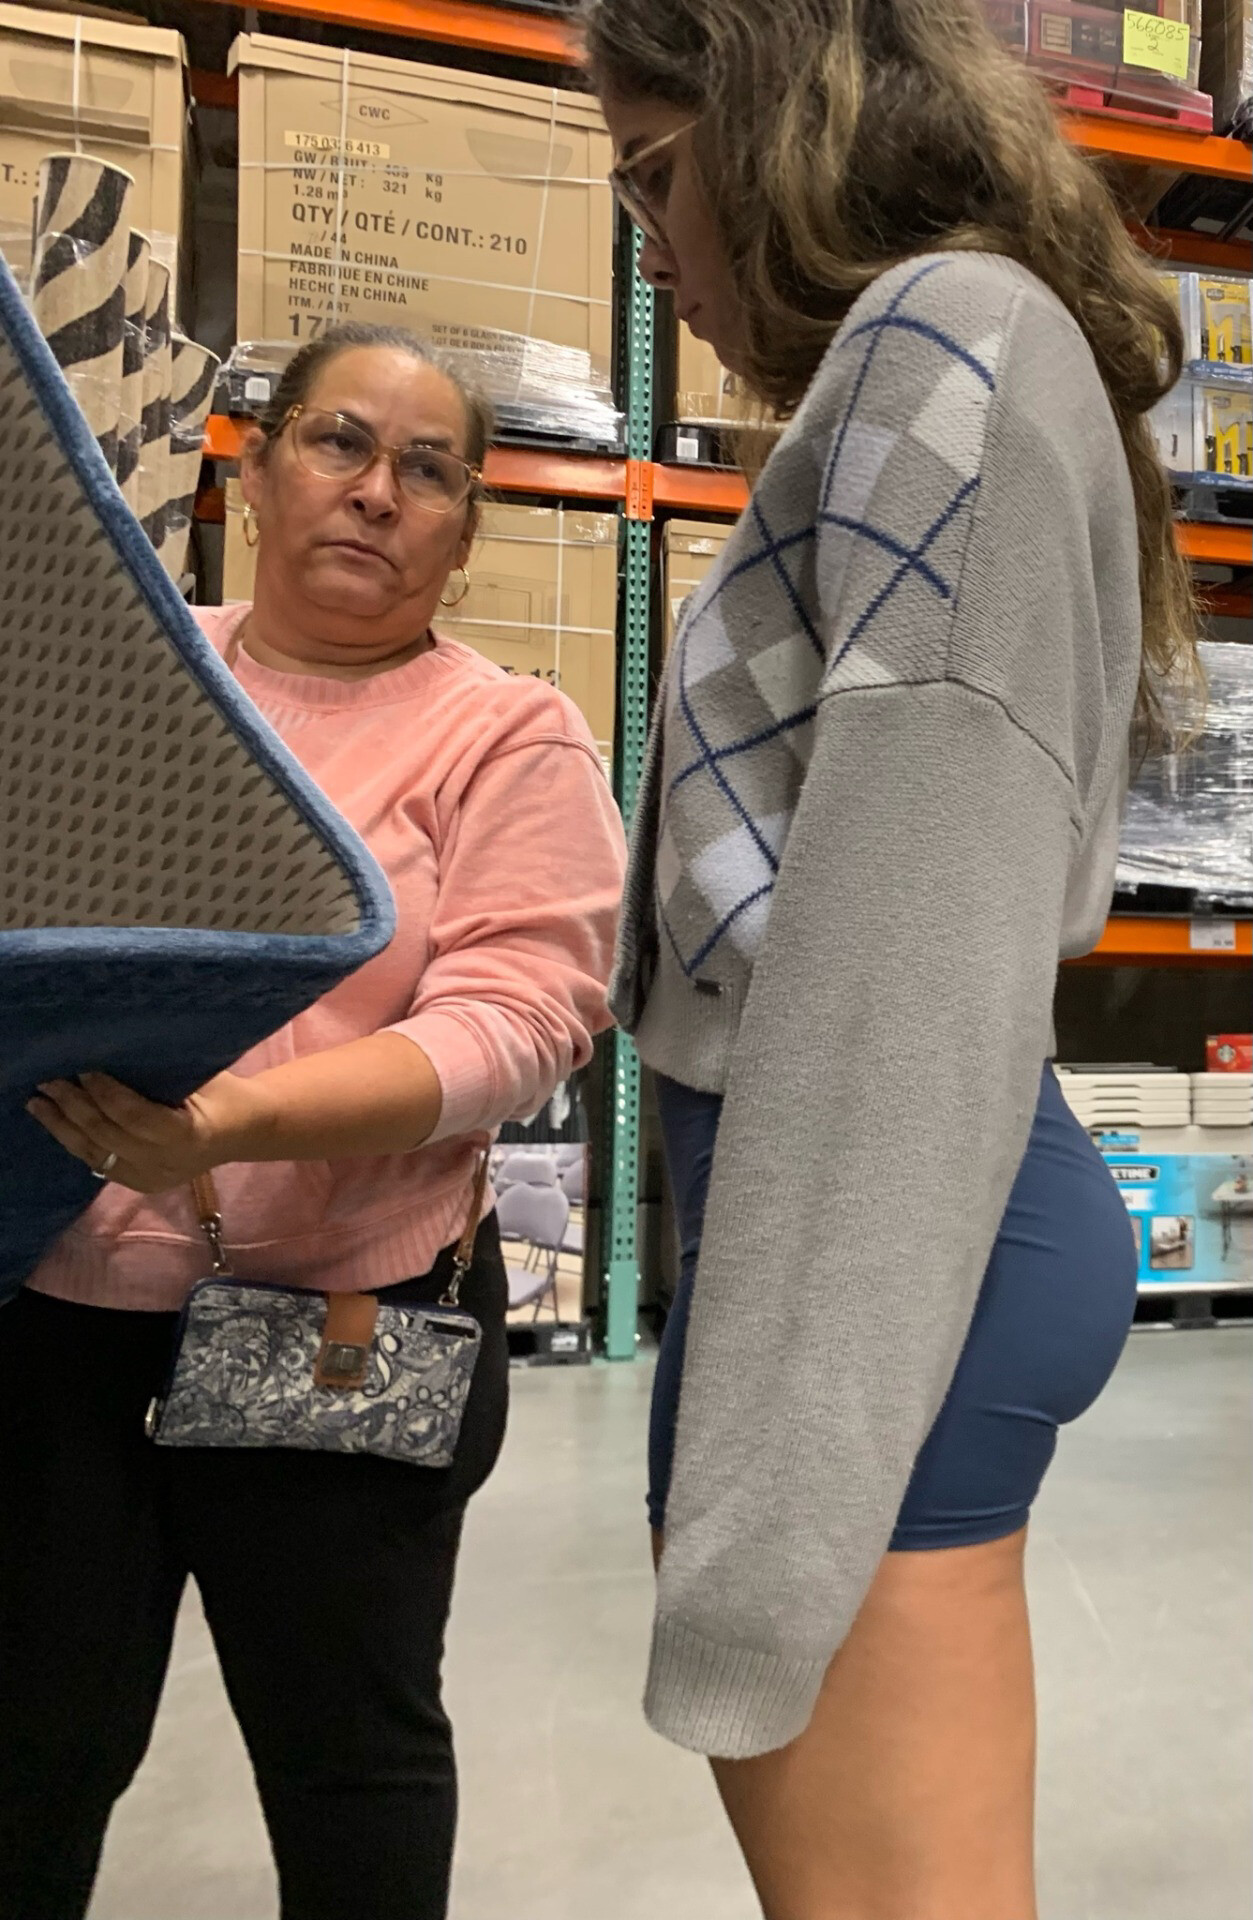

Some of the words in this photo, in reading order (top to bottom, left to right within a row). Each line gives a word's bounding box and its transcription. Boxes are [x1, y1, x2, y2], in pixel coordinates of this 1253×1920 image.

[1126, 13, 1188, 41] 566085
[359, 105, 391, 121] CWC
[294, 150, 317, 165] GW
[293, 168, 317, 182] NW
[330, 171, 358, 187] NET
[383, 180, 407, 195] 321
[425, 187, 443, 203] kg
[293, 183, 323, 199] 1.28
[292, 202, 334, 226] QTY
[340, 209, 349, 227] /
[355, 209, 396, 235] QTÉ
[401, 219, 411, 237] /
[416, 221, 485, 249] CONT.:
[490, 233, 528, 256] 210
[290, 242, 333, 259] MADE
[355, 252, 399, 269] CHINA
[365, 270, 383, 285] EN
[387, 273, 430, 291] CHINE
[288, 295, 315, 309] ITM.
[341, 284, 360, 298] EN
[363, 288, 408, 305] CHINA
